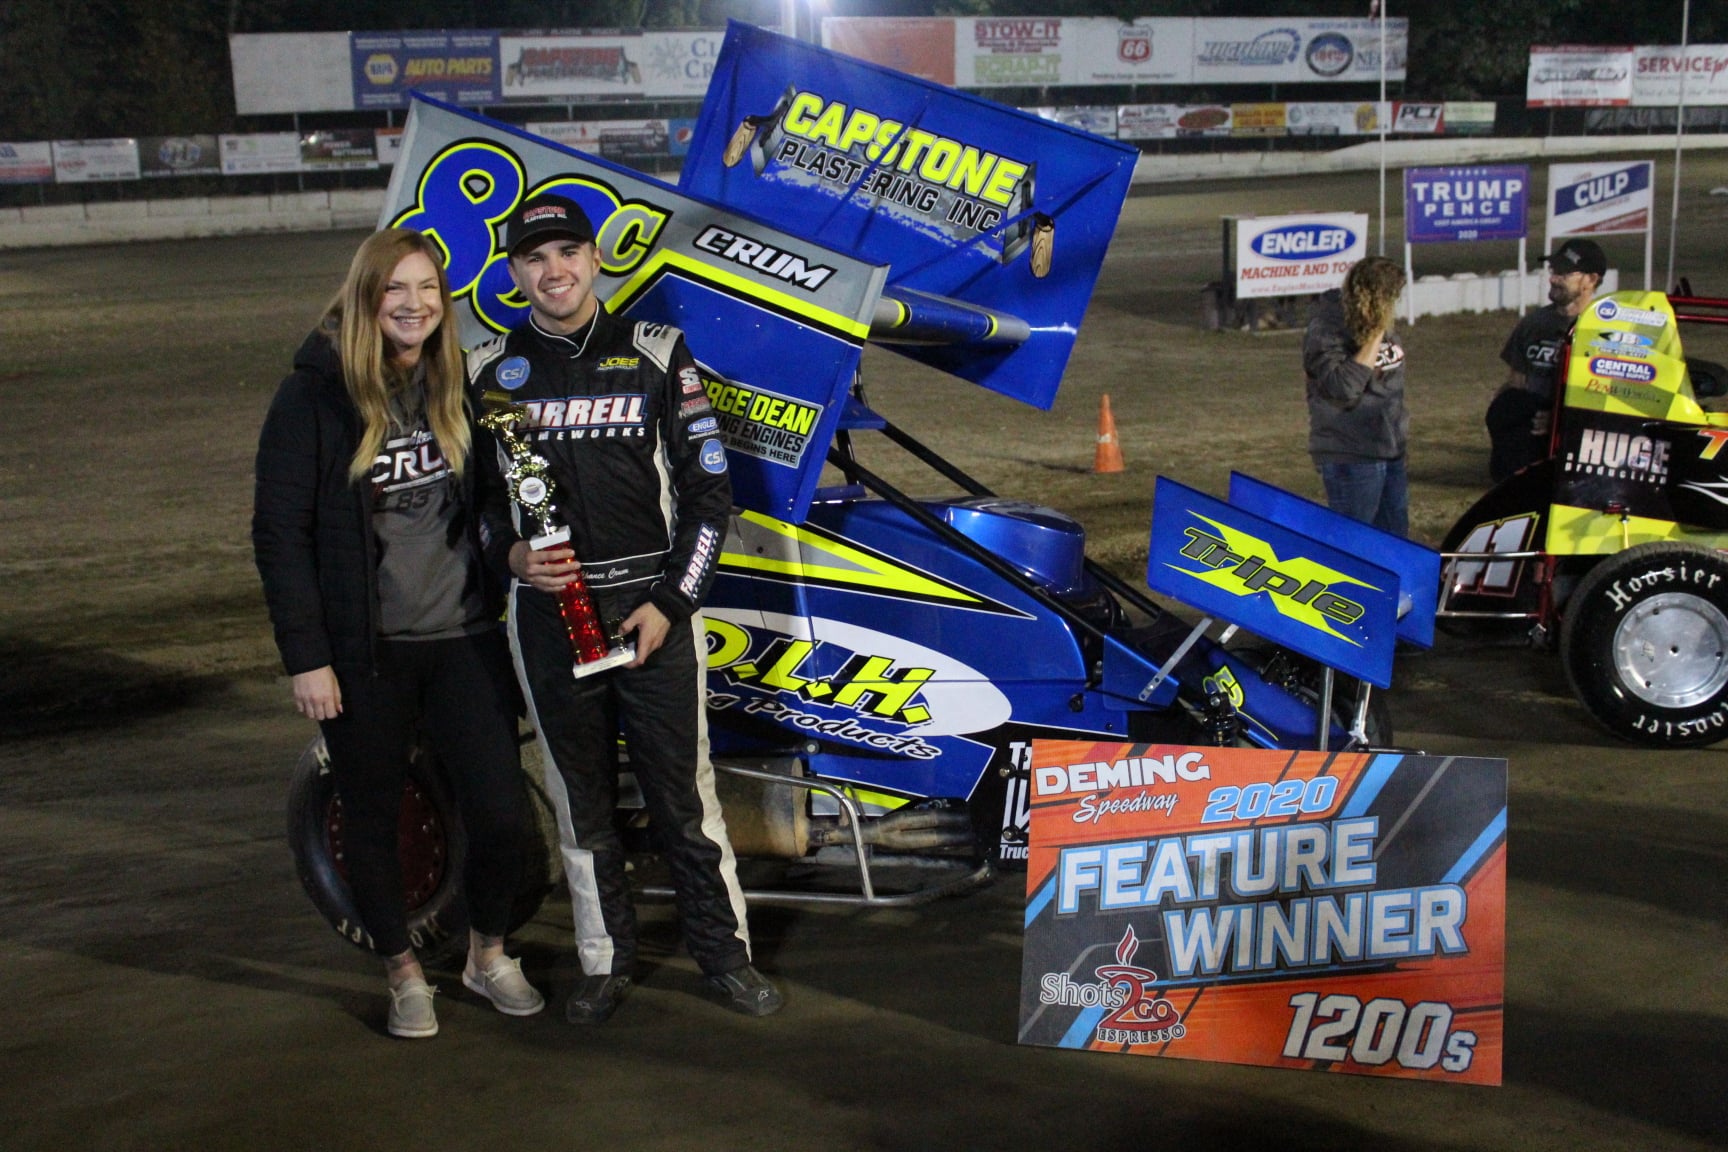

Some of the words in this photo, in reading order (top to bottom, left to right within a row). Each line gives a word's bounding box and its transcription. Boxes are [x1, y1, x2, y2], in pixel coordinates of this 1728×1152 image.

[975, 20, 1061, 39] STOW-IT
[1123, 40, 1147, 57] 66
[404, 58, 446, 76] AUTO
[446, 57, 493, 75] PARTS
[781, 91, 1029, 209] CAPSTONE
[775, 137, 939, 214] PLASTERING
[1411, 179, 1522, 202] TRUMP
[1573, 171, 1629, 207] CULP
[1424, 200, 1510, 218] PENCE
[693, 225, 836, 291] CRUM
[1260, 229, 1348, 255] ENGLER
[1241, 264, 1301, 280] MACHINE
[1302, 262, 1329, 277] AND
[599, 357, 640, 368] JOES
[1596, 358, 1651, 375] CENTRAL
[511, 398, 644, 429] ARRELL
[749, 393, 816, 436] DEAN
[741, 418, 806, 454] ENGINES
[769, 447, 797, 465] HERE
[1578, 429, 1672, 475] HUGE
[1180, 526, 1367, 625] Triple
[1605, 561, 1721, 612] Hoosier
[743, 696, 943, 760] Products
[1631, 700, 1728, 740] oosier
[1035, 752, 1210, 796] DEMING
[1072, 791, 1179, 825] Speedway
[1200, 776, 1340, 824] 2020
[1058, 816, 1379, 914] FEATURE
[1164, 883, 1468, 977] WINNER
[1040, 972, 1125, 1009] Shots
[1134, 999, 1173, 1021] GO
[1096, 1022, 1187, 1046] ESPRESSO
[1283, 992, 1477, 1074] 1200s
